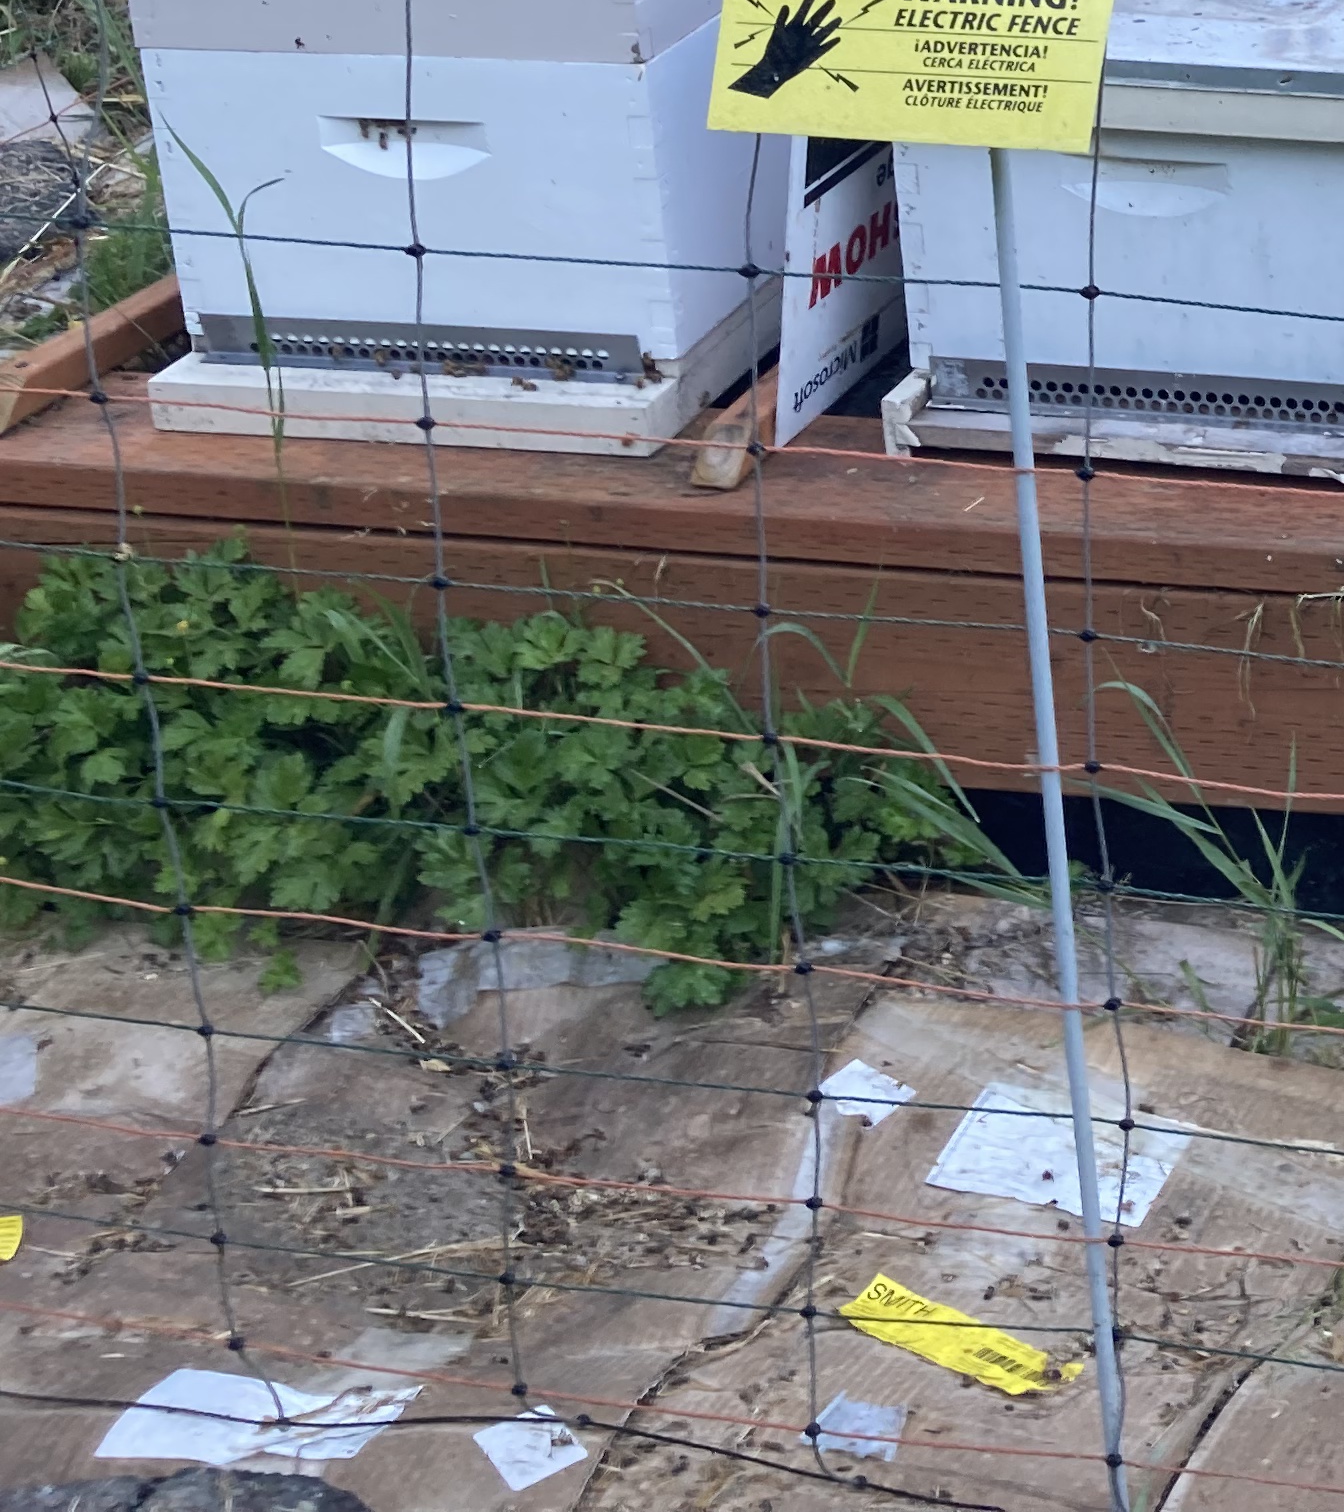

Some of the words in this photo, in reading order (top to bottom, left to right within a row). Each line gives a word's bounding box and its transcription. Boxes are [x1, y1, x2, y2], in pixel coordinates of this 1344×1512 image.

[894, 8, 1002, 31] ELECTRIC
[1007, 14, 1082, 36] FENCE
[914, 39, 1048, 59] ¡ADVERTENCIA!
[923, 57, 963, 69] CERCA
[902, 78, 1048, 99] AVERTISSEMENT!
[905, 93, 961, 109] CLÔTURE
[965, 95, 1044, 114] ÉLECTRIQUE
[808, 200, 900, 310] HOW
[793, 340, 858, 414] Microsoft
